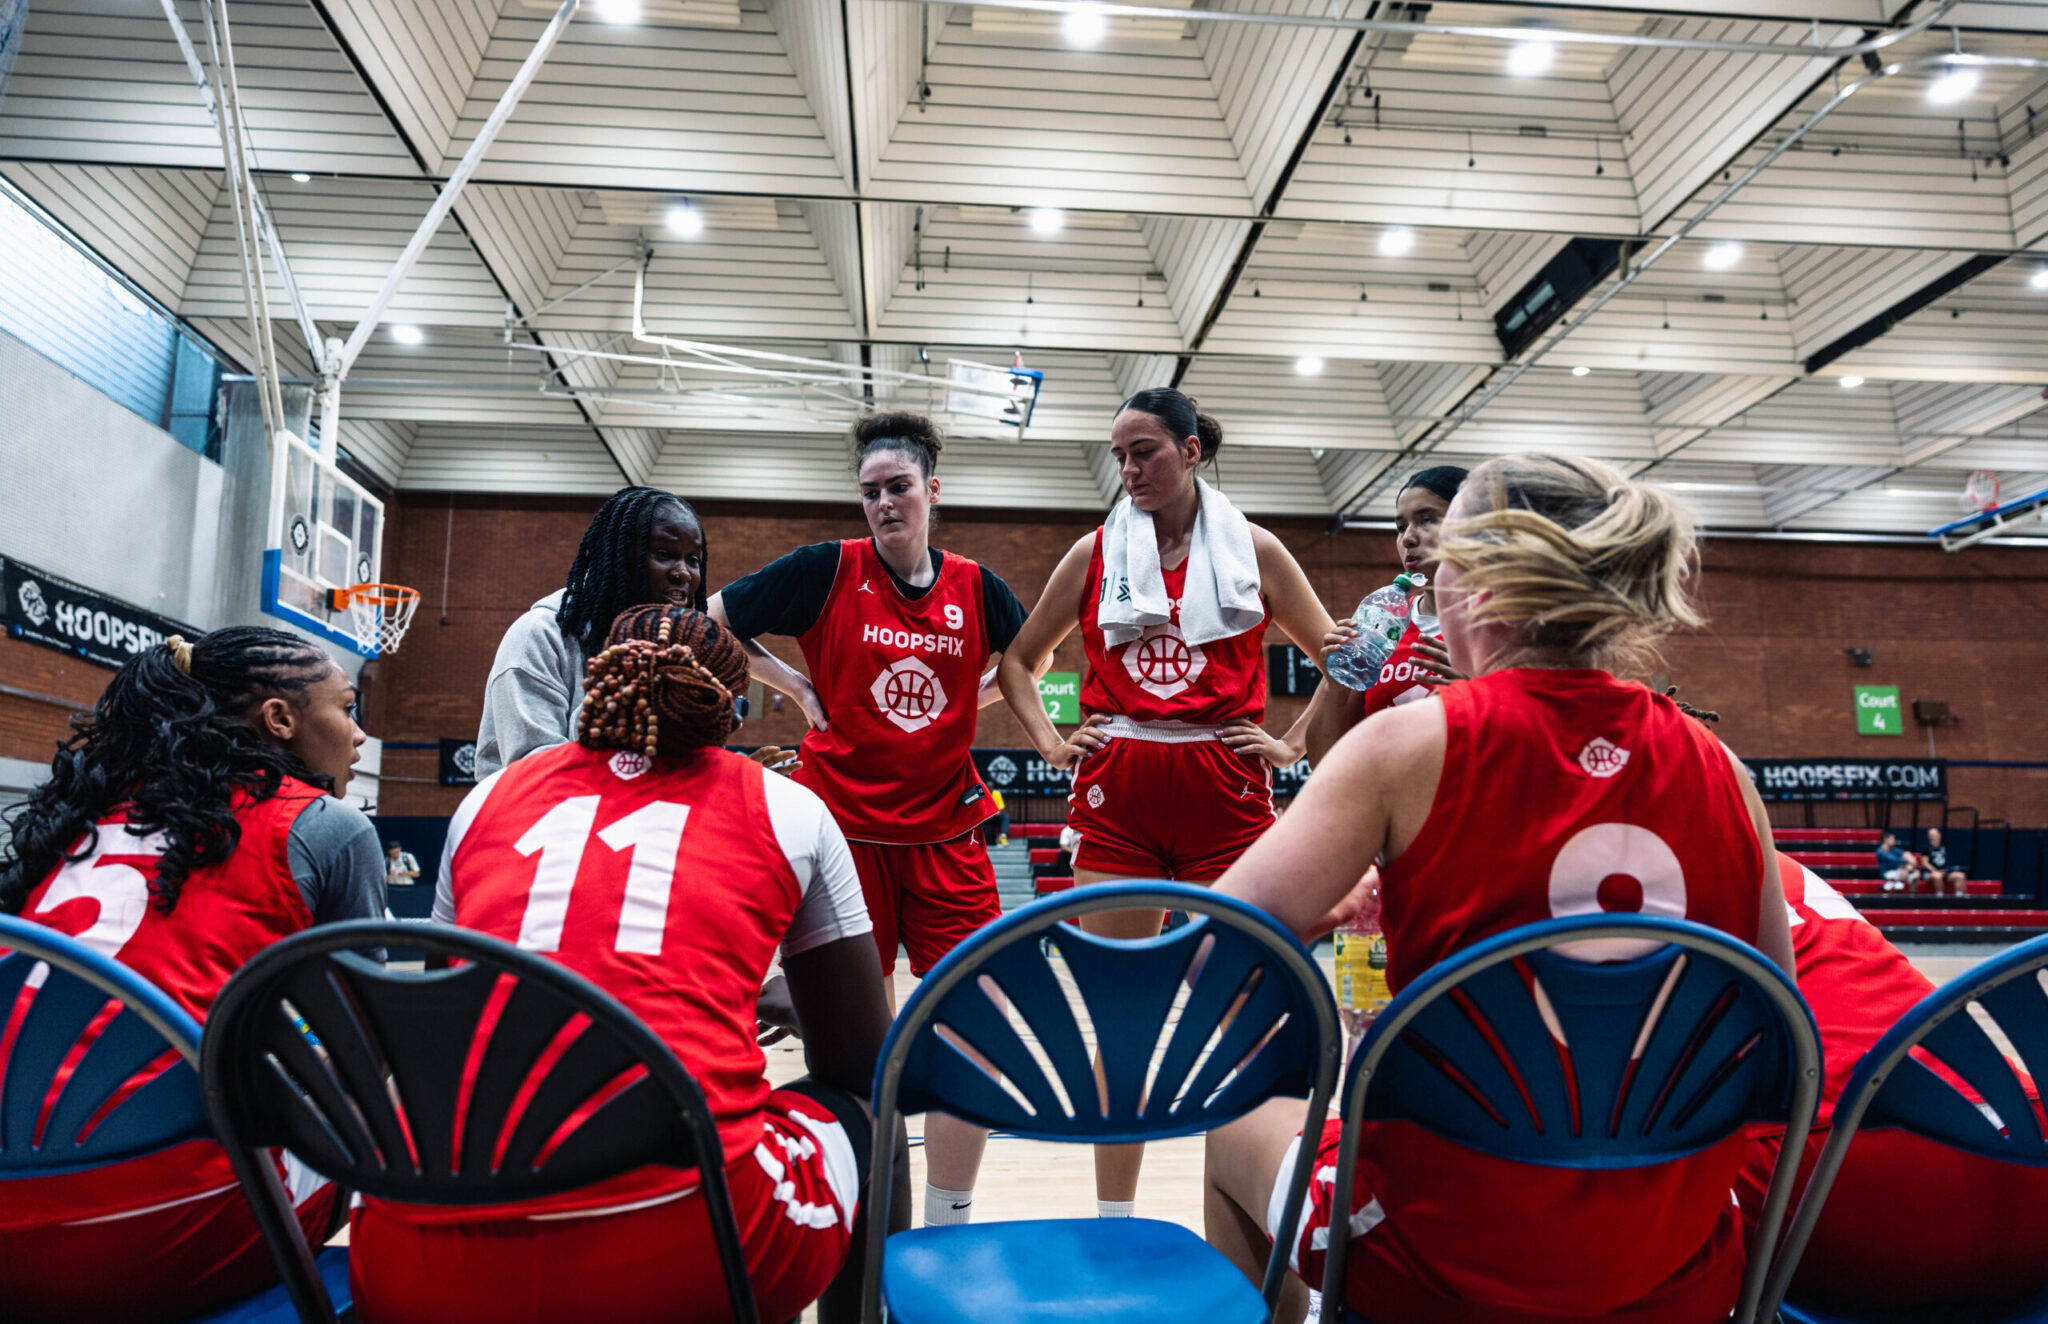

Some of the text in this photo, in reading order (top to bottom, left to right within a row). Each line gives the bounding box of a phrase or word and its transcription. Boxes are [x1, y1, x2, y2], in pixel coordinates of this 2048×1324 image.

[943, 603, 964, 630] 9
[862, 624, 965, 658] HOOPSFIX
[1037, 679, 1075, 696] Court
[1049, 700, 1061, 719] 2
[1859, 692, 1898, 709] Court
[1872, 711, 1886, 731] 4
[1763, 764, 1939, 788] HOOPSFIX.COM
[513, 794, 691, 957] 11
[27, 823, 170, 988] 5
